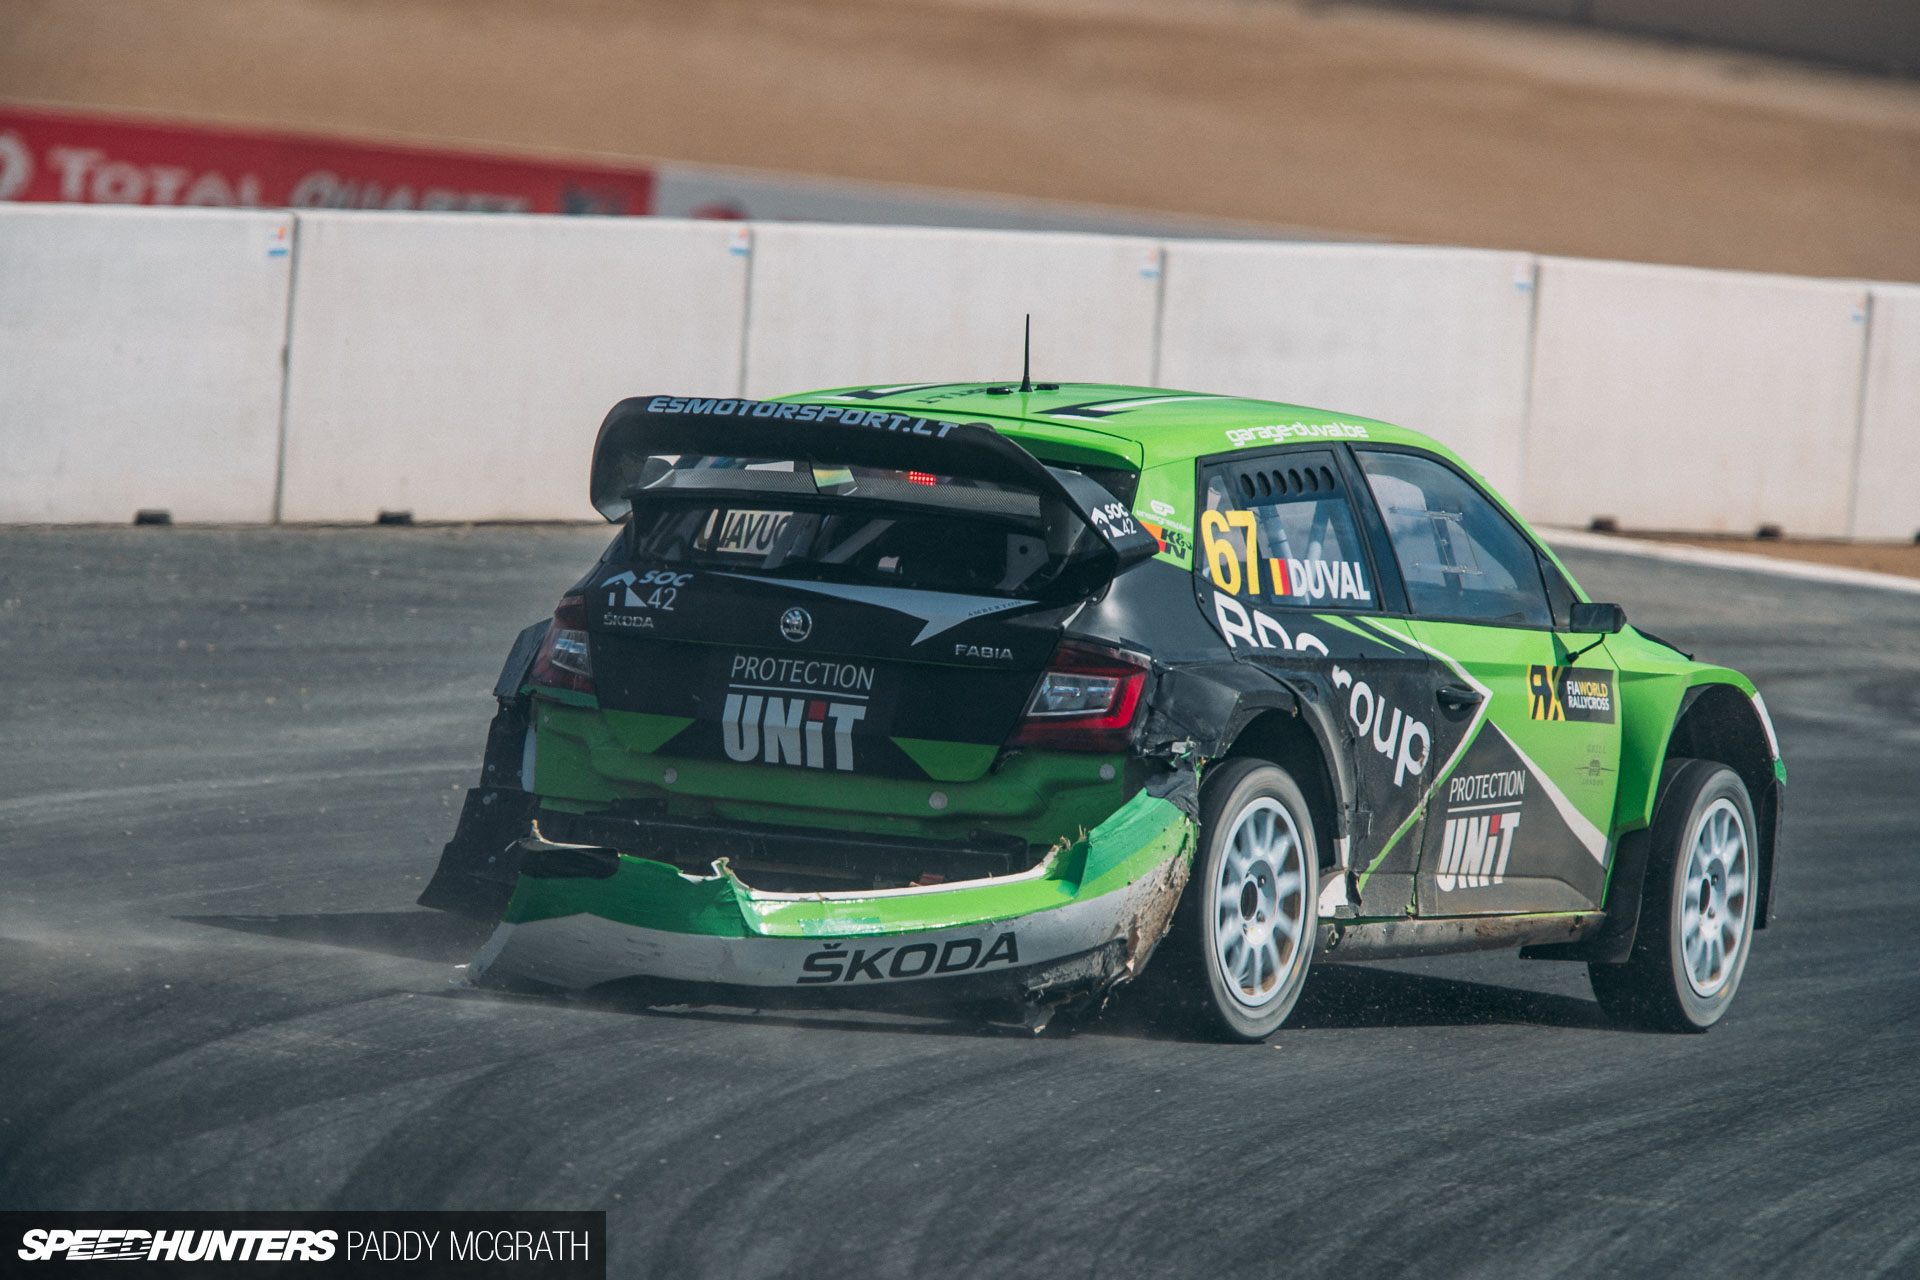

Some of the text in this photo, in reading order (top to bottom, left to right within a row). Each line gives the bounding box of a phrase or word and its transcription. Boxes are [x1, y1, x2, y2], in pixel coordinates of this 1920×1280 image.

[647, 396, 959, 439] ESMOTORSPORT.LT
[1104, 502, 1128, 520] SOC
[1122, 518, 1137, 535] 42
[1201, 509, 1260, 596] 67
[639, 570, 694, 587] SOC
[1288, 557, 1371, 600] DUVAL
[647, 586, 677, 611] 42
[955, 644, 1014, 660] FABIA
[731, 655, 875, 691] PROTECTION
[1567, 695, 1610, 711] RALLYCROSS
[1449, 770, 1526, 803] PROTECTION
[797, 931, 1020, 985] ŠKODA
